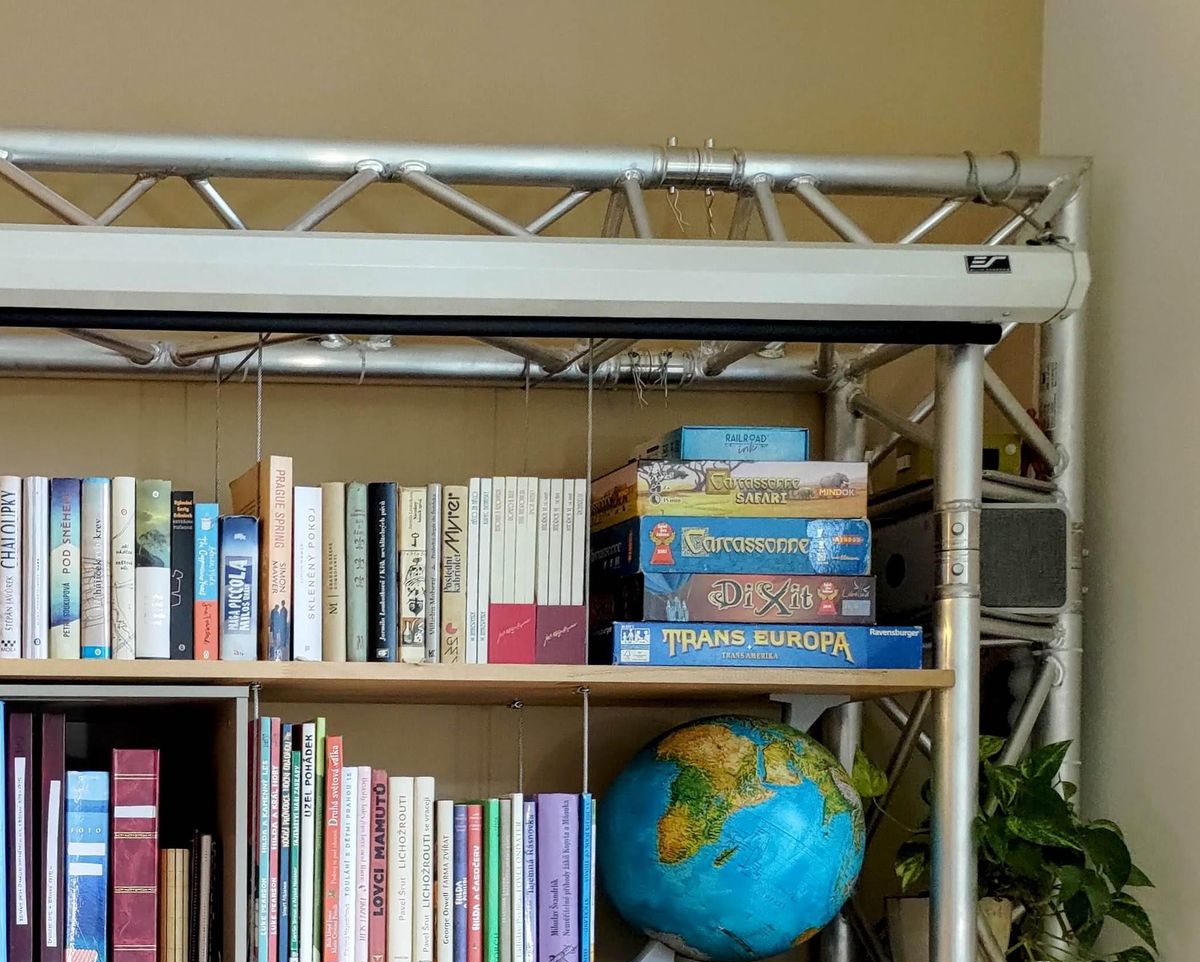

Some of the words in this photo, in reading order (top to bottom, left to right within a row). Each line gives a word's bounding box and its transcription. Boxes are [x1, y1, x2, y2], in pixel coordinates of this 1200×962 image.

[725, 433, 768, 444] RAILROAD
[275, 470, 285, 508] PRAGUE
[708, 472, 800, 491] Carcassonne
[818, 488, 855, 497] MINDOK
[735, 492, 788, 505] SAFARI
[274, 512, 285, 548] SPRING
[308, 508, 316, 548] POKOJ
[444, 492, 462, 553] Myrer
[683, 529, 810, 555] Carcassonne
[63, 550, 71, 574] POD
[278, 562, 286, 593] SIMON
[444, 556, 453, 593] Poslední
[452, 554, 461, 593] kabriolet
[228, 559, 247, 608] PICCOLA
[306, 555, 316, 619] SKLENĚNÝ
[661, 629, 746, 656] TRANS
[754, 630, 854, 664] EUROPA
[870, 629, 919, 638] Ravensburger
[302, 734, 313, 786] POHÁDEK
[260, 779, 268, 818] KAMENNÝ
[330, 768, 339, 798] světová
[270, 790, 278, 810] KRÁL
[304, 789, 312, 817] UZEL
[329, 800, 339, 826] Druhá
[372, 783, 386, 859] MAMUTŮ
[395, 795, 406, 869] LICHOŽROUTI
[424, 823, 430, 831] se
[441, 835, 449, 860] ZVÍŘAT
[421, 834, 431, 908] LICHOŽROUTI
[472, 845, 480, 892] ČASOČERV
[526, 859, 534, 895] Tajemná
[373, 868, 385, 916] LOVCI
[396, 877, 406, 896] Šrut
[455, 881, 463, 905] HILDA
[398, 898, 406, 921] Pavel
[421, 915, 429, 931] Šrut
